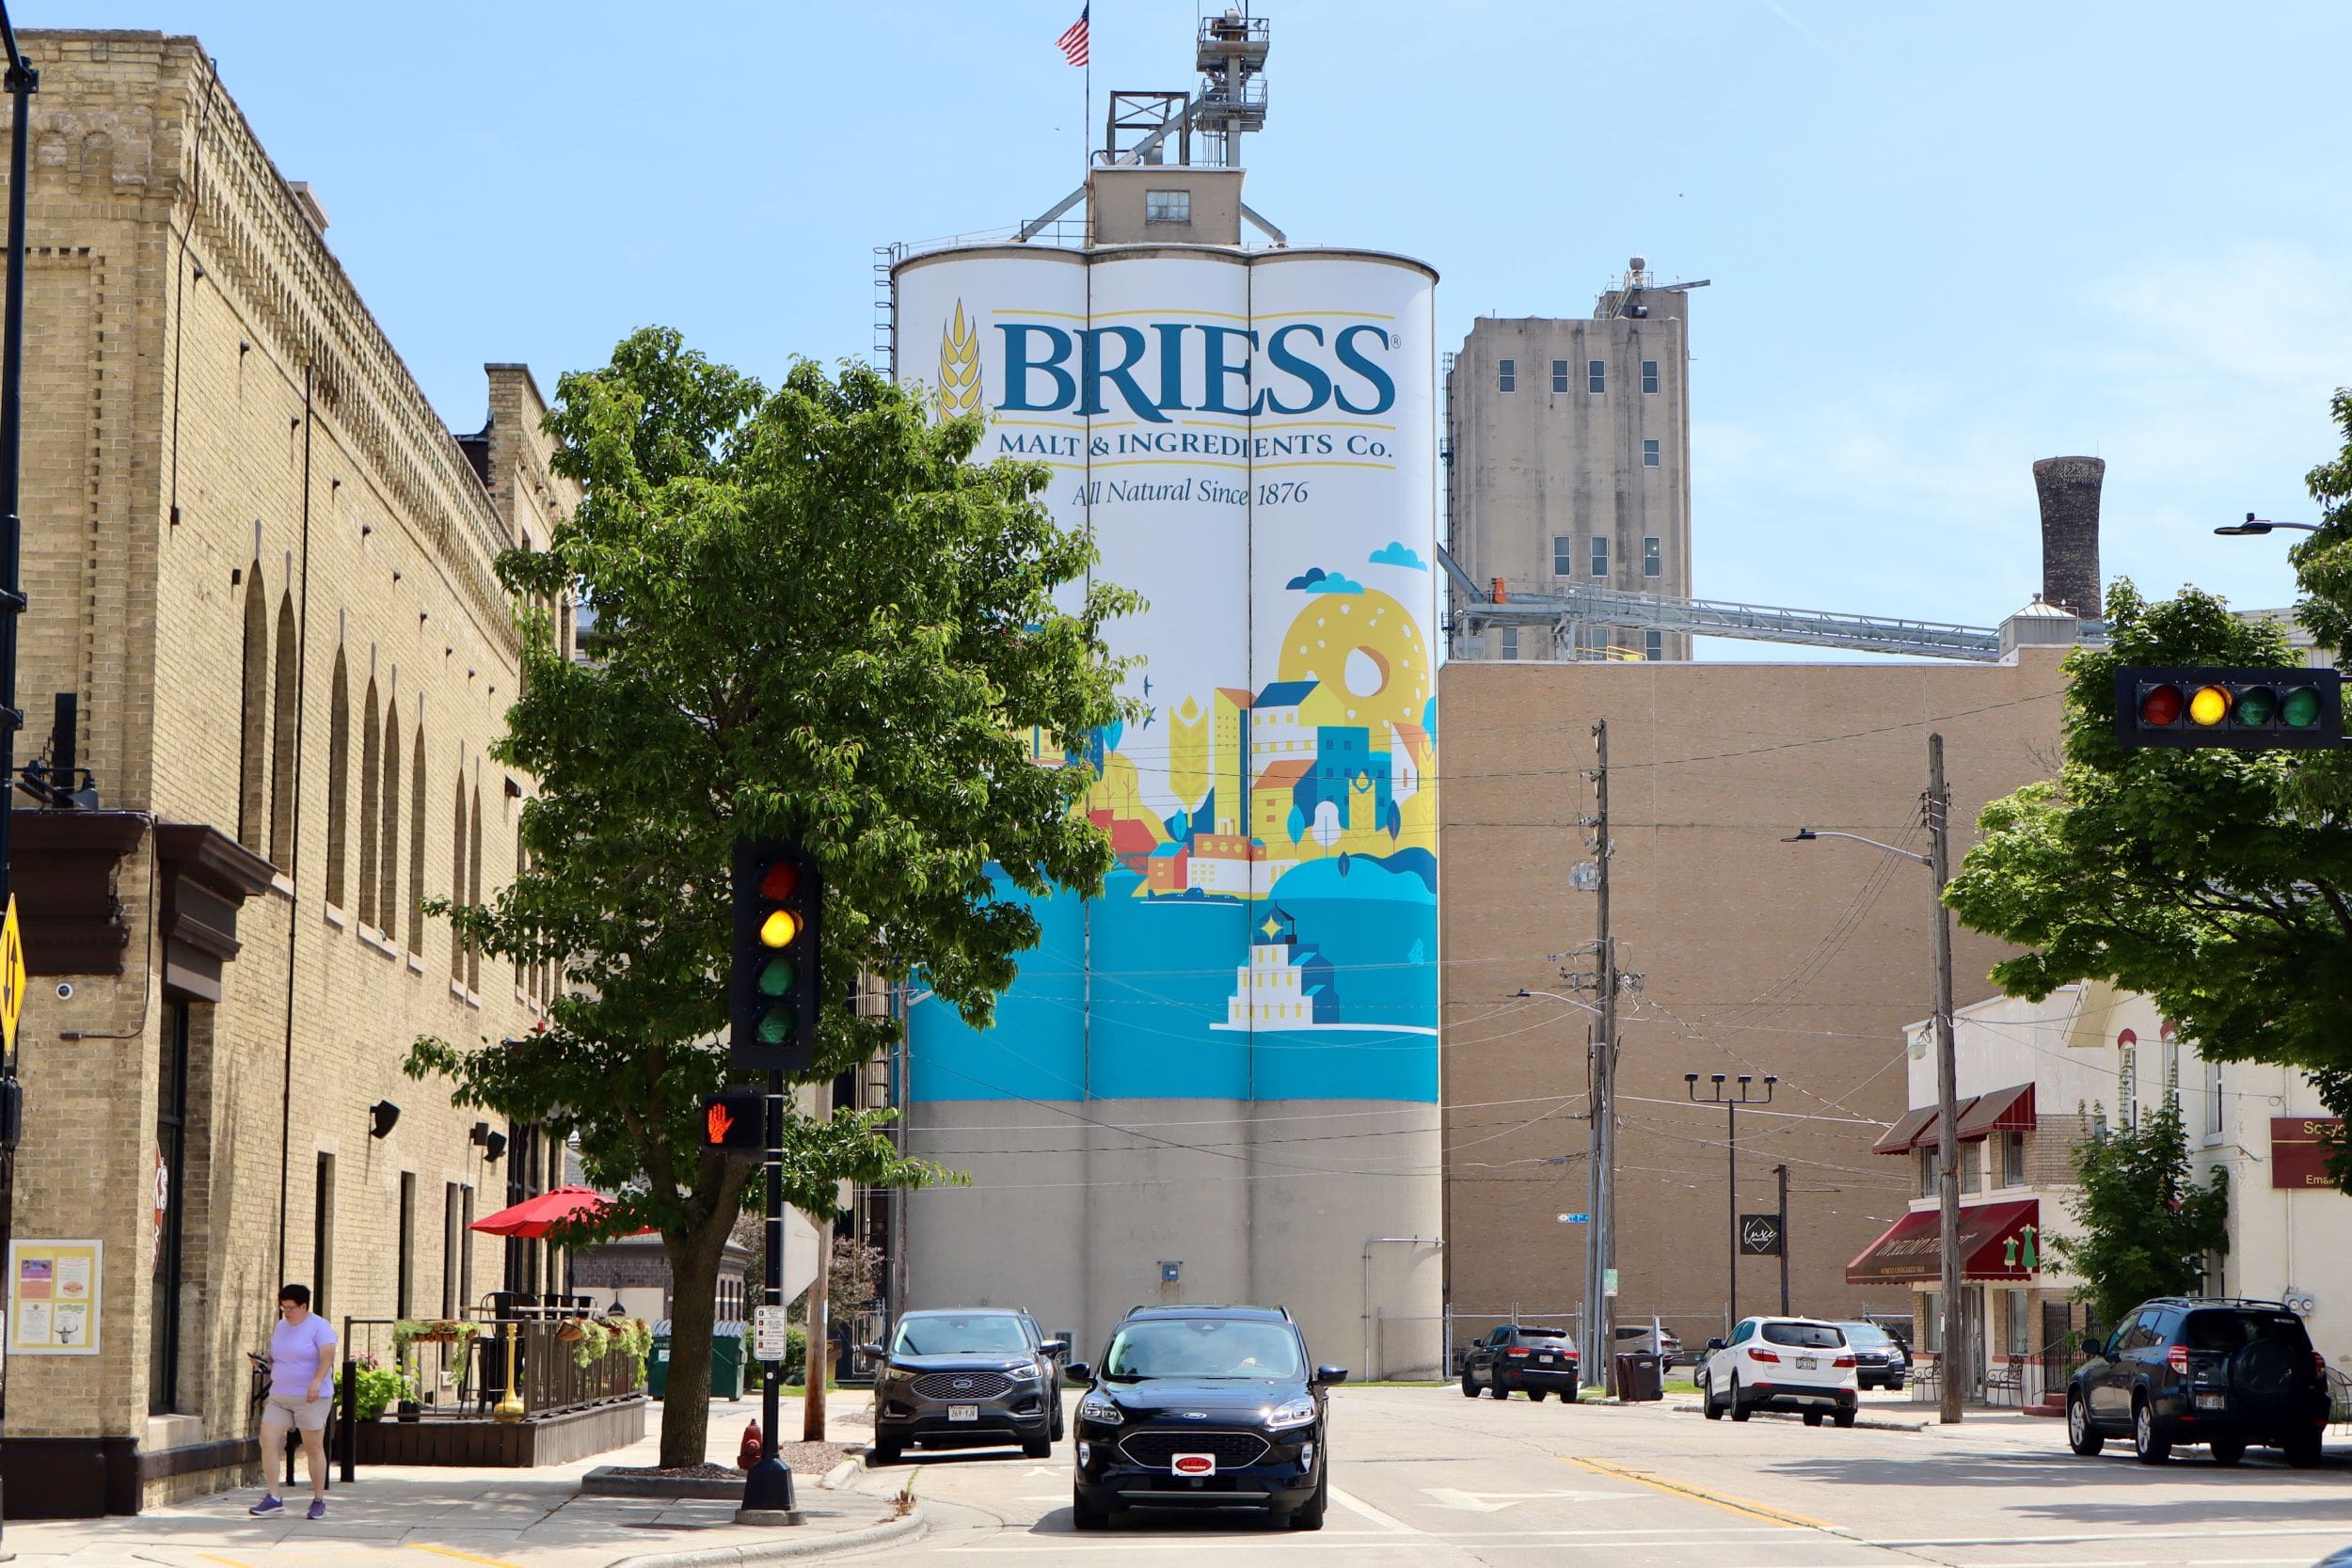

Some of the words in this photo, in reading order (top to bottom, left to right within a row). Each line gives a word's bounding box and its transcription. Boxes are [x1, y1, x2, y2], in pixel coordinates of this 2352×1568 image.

[993, 323, 1395, 423] BRIESS
[999, 432, 1080, 457] MALT
[1089, 436, 1109, 456] &
[1118, 432, 1332, 458] INGREDIENTS
[1347, 435, 1392, 458] Co.
[1072, 481, 1101, 506] All
[1106, 480, 1191, 504] Natural
[1198, 480, 1248, 506] Since
[1258, 481, 1309, 506] 1876
[1744, 1220, 1777, 1244] Luxe
